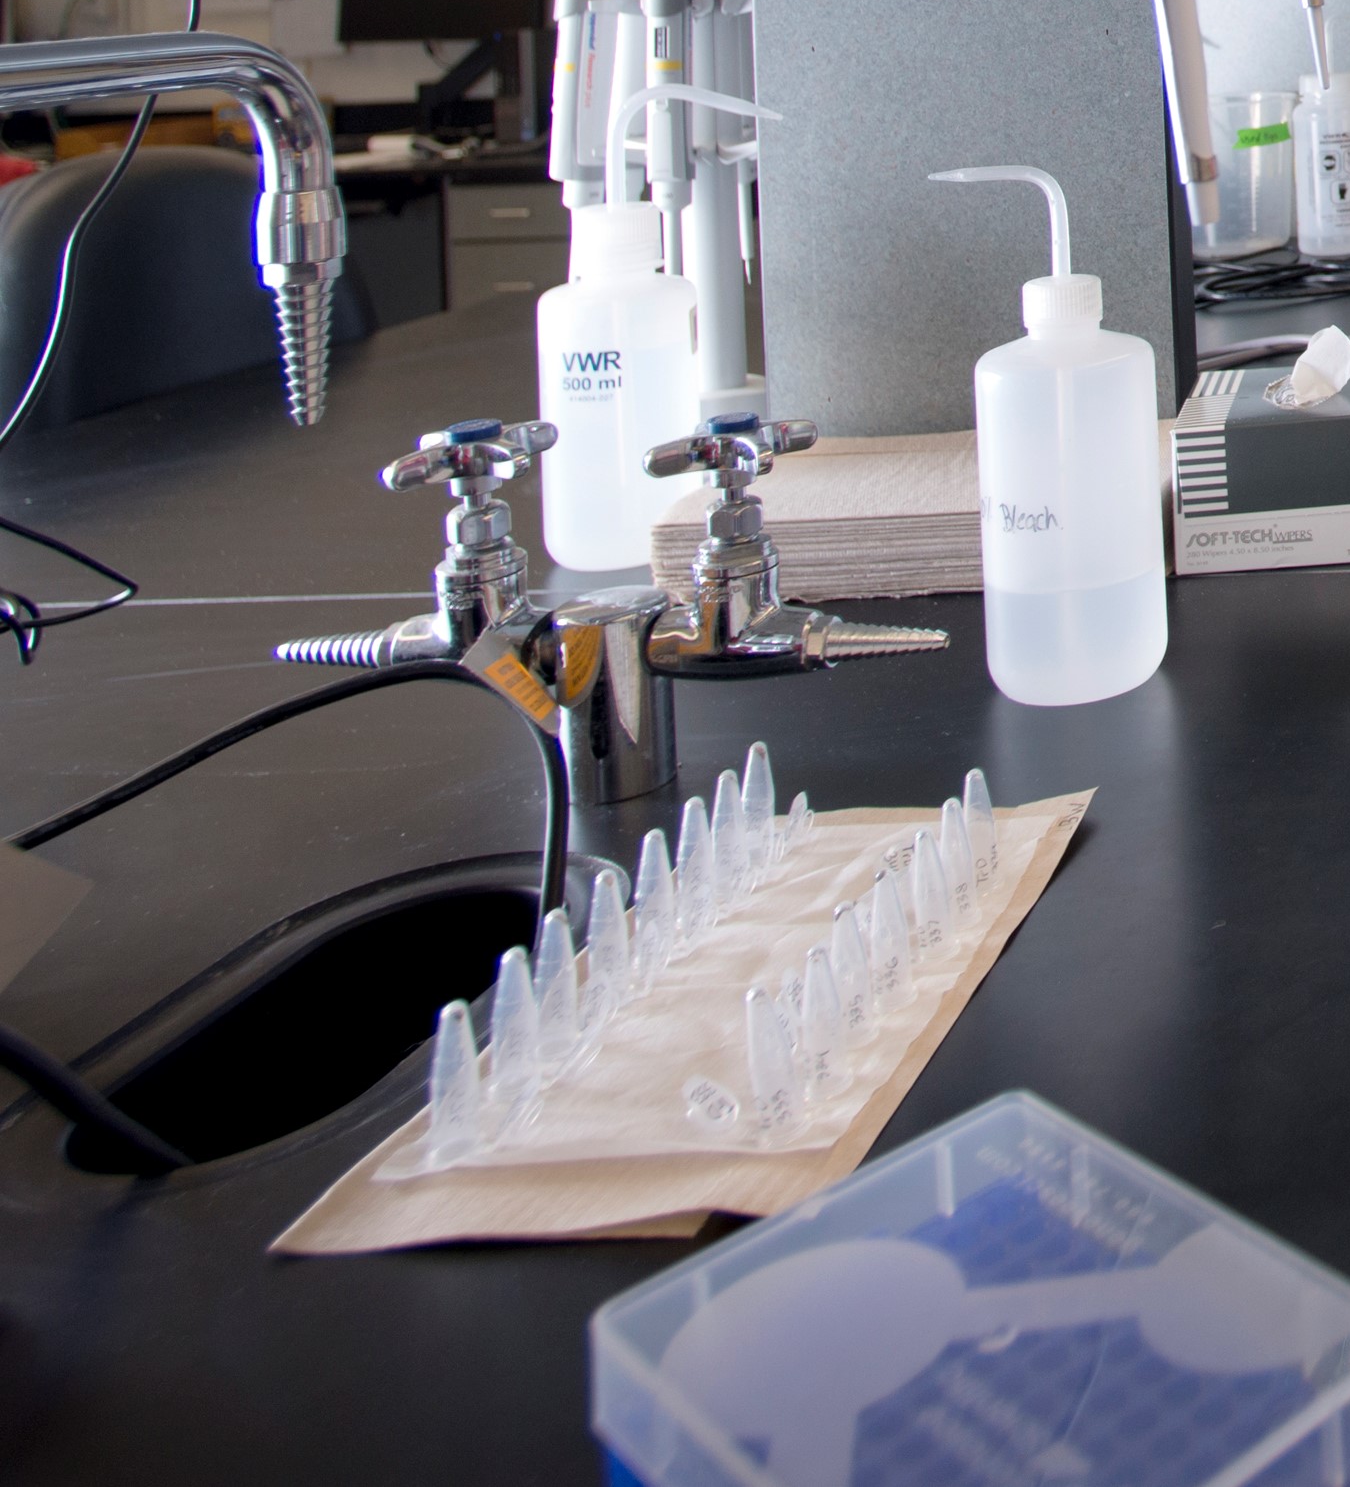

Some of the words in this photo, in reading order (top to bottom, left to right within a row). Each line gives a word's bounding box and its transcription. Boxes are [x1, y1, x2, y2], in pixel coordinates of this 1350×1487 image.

[562, 350, 622, 372] VWR
[562, 377, 592, 391] 500
[598, 375, 622, 390] ml
[1274, 528, 1313, 544] WIPERS
[1202, 548, 1227, 558] Wipers
[1271, 544, 1294, 553] inches
[955, 883, 971, 914] 338
[927, 919, 943, 948] 337
[884, 955, 899, 994] 336
